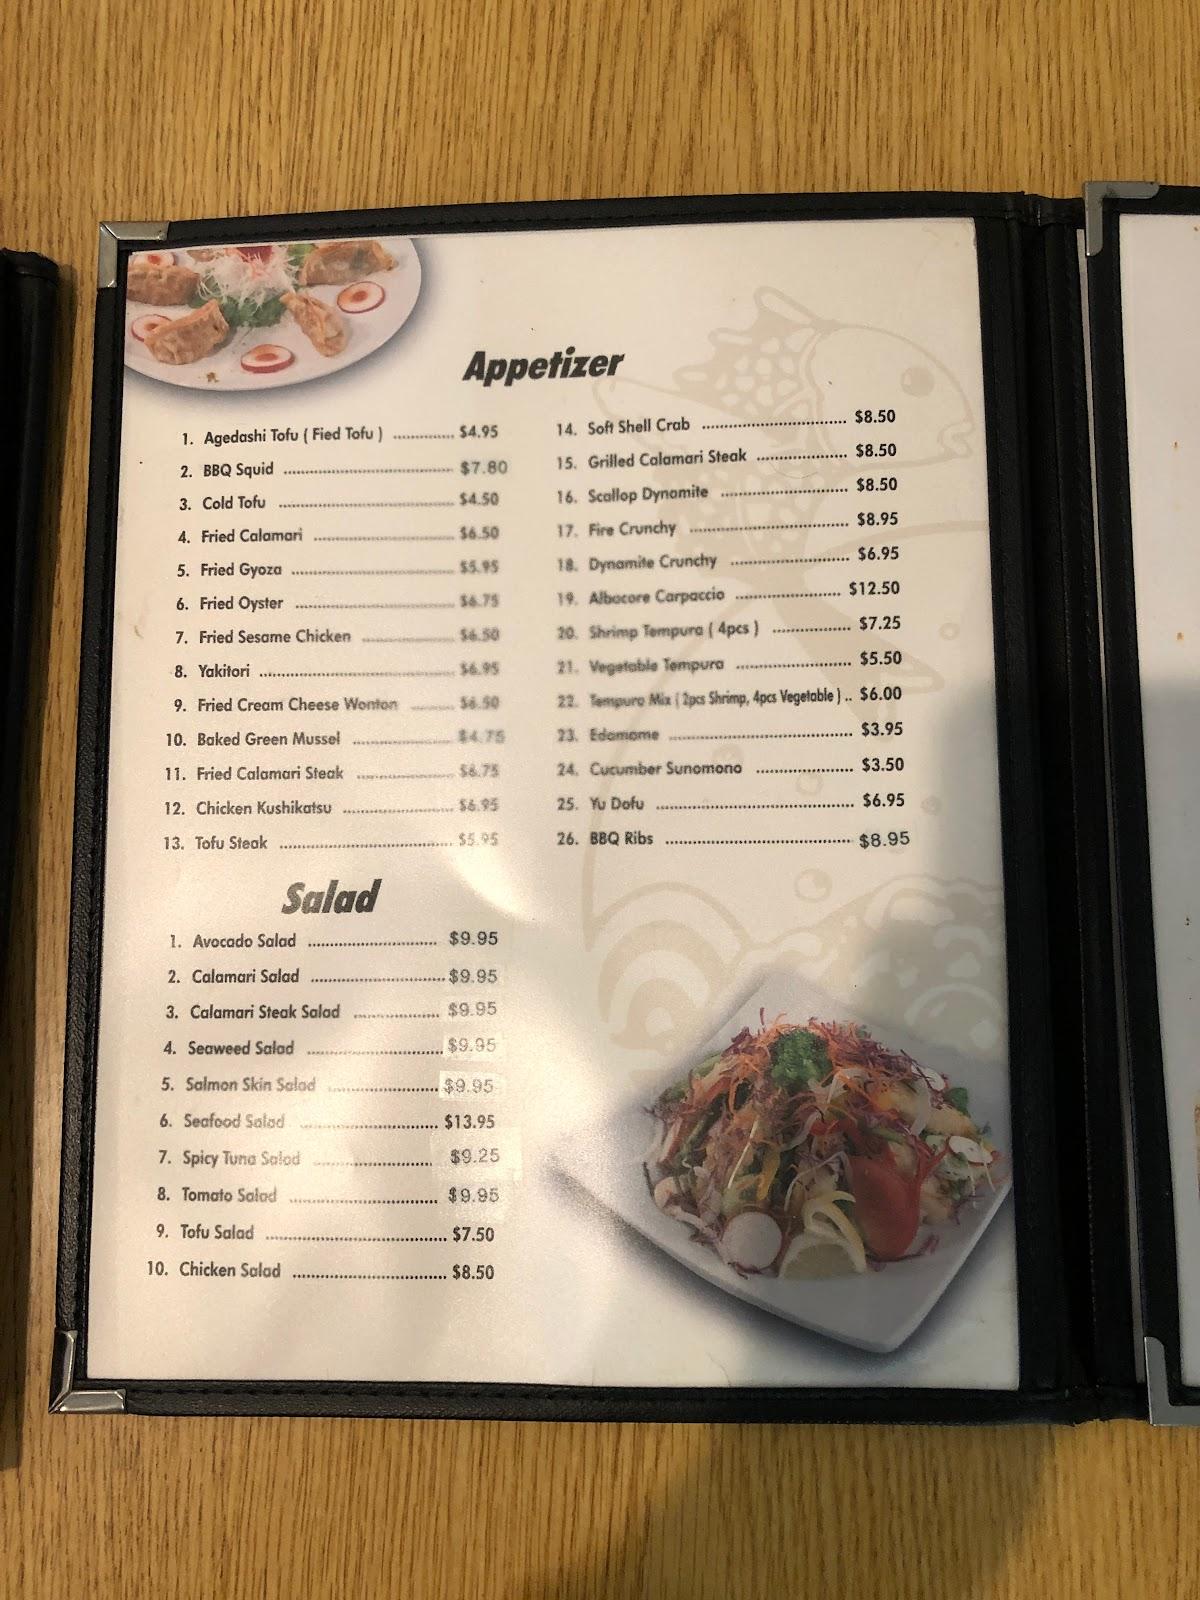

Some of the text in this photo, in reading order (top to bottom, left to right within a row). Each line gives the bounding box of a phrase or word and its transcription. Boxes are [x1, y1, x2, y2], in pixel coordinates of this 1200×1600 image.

[462, 346, 625, 387] Appetizer
[557, 410, 895, 436] 14. Soft Shell Crab $8.50
[183, 425, 498, 447] 1. Agedashi Tofu Fied Tofu $4.95
[557, 443, 896, 470] 15. Grilled Calamari Steak $8.50
[181, 460, 508, 479] 2. BBQ Squid $7.80
[558, 477, 897, 504] 16. Scallop Dynamite $8.50
[179, 492, 499, 511] 3. Cold Tofu $4.50
[589, 523, 614, 536] Fire
[619, 520, 677, 537] Crunchy
[857, 512, 898, 527] $8.95
[178, 526, 499, 543] 4. Fried Calamari $6.50
[589, 546, 899, 574] Dynamite Crunchy $6.95
[177, 564, 189, 577] 5.
[201, 562, 234, 576] Fried
[239, 563, 282, 579] Gyoza
[655, 587, 725, 605] Carpaccio
[849, 581, 900, 596] $12.50
[177, 596, 283, 613] 6. Fried Oyster
[176, 629, 351, 644] 7. Fried Sesame Chicken
[589, 616, 900, 642] Shrimp Tempura 4pcs $7.25
[175, 664, 249, 678] 8. Yakitori
[589, 651, 902, 677] Vegetable Tempura $5.50
[174, 697, 398, 712] 9. Fried Cream Cheese Wonton
[590, 693, 646, 710] Tempura
[648, 692, 671, 706] Mix
[682, 691, 706, 709] 2pcs
[753, 690, 777, 707] 4pcs
[780, 688, 834, 706] Vegetable
[860, 686, 902, 701] $6.00
[166, 731, 340, 746] 10. Baked Green Mussel
[862, 722, 903, 737] $3.95
[166, 767, 186, 780] 11.
[197, 766, 232, 780] Fried
[237, 766, 300, 780] Calamari
[306, 765, 343, 780] Steak
[557, 757, 904, 776] 24. Cucumber Sunomono $3.50
[165, 797, 500, 815] 12. Chicken Kushikatsu $6.95
[557, 793, 904, 811] 25. Yu Dofu $6.95
[164, 836, 184, 850] 13.
[195, 835, 224, 849] Tofu
[229, 835, 267, 849] Steak
[557, 830, 910, 849] 26. BBQ Ribs $8.95
[281, 879, 382, 914] Salad
[171, 931, 498, 948] 1. Avocado Salad $9.95
[168, 968, 497, 984] 2. Calamari Salad $9.95
[166, 1001, 497, 1019] 3. Calamari Steak Salad $9.95
[163, 1037, 496, 1055] 4. Seaweed Salad $9.95
[161, 1076, 493, 1095] 5. Salmon Skin Salad $9.95
[160, 1112, 495, 1130] 6. Seafood Salad $13.95
[159, 1148, 500, 1168] 7. Spicy Tuna Salad $9.25
[157, 1187, 499, 1204] 8. Tomato Salad $9.95
[156, 1223, 494, 1242] 9. Tofu Salad $7.50
[148, 1261, 494, 1280] 10. Chicken Salad $8.50
